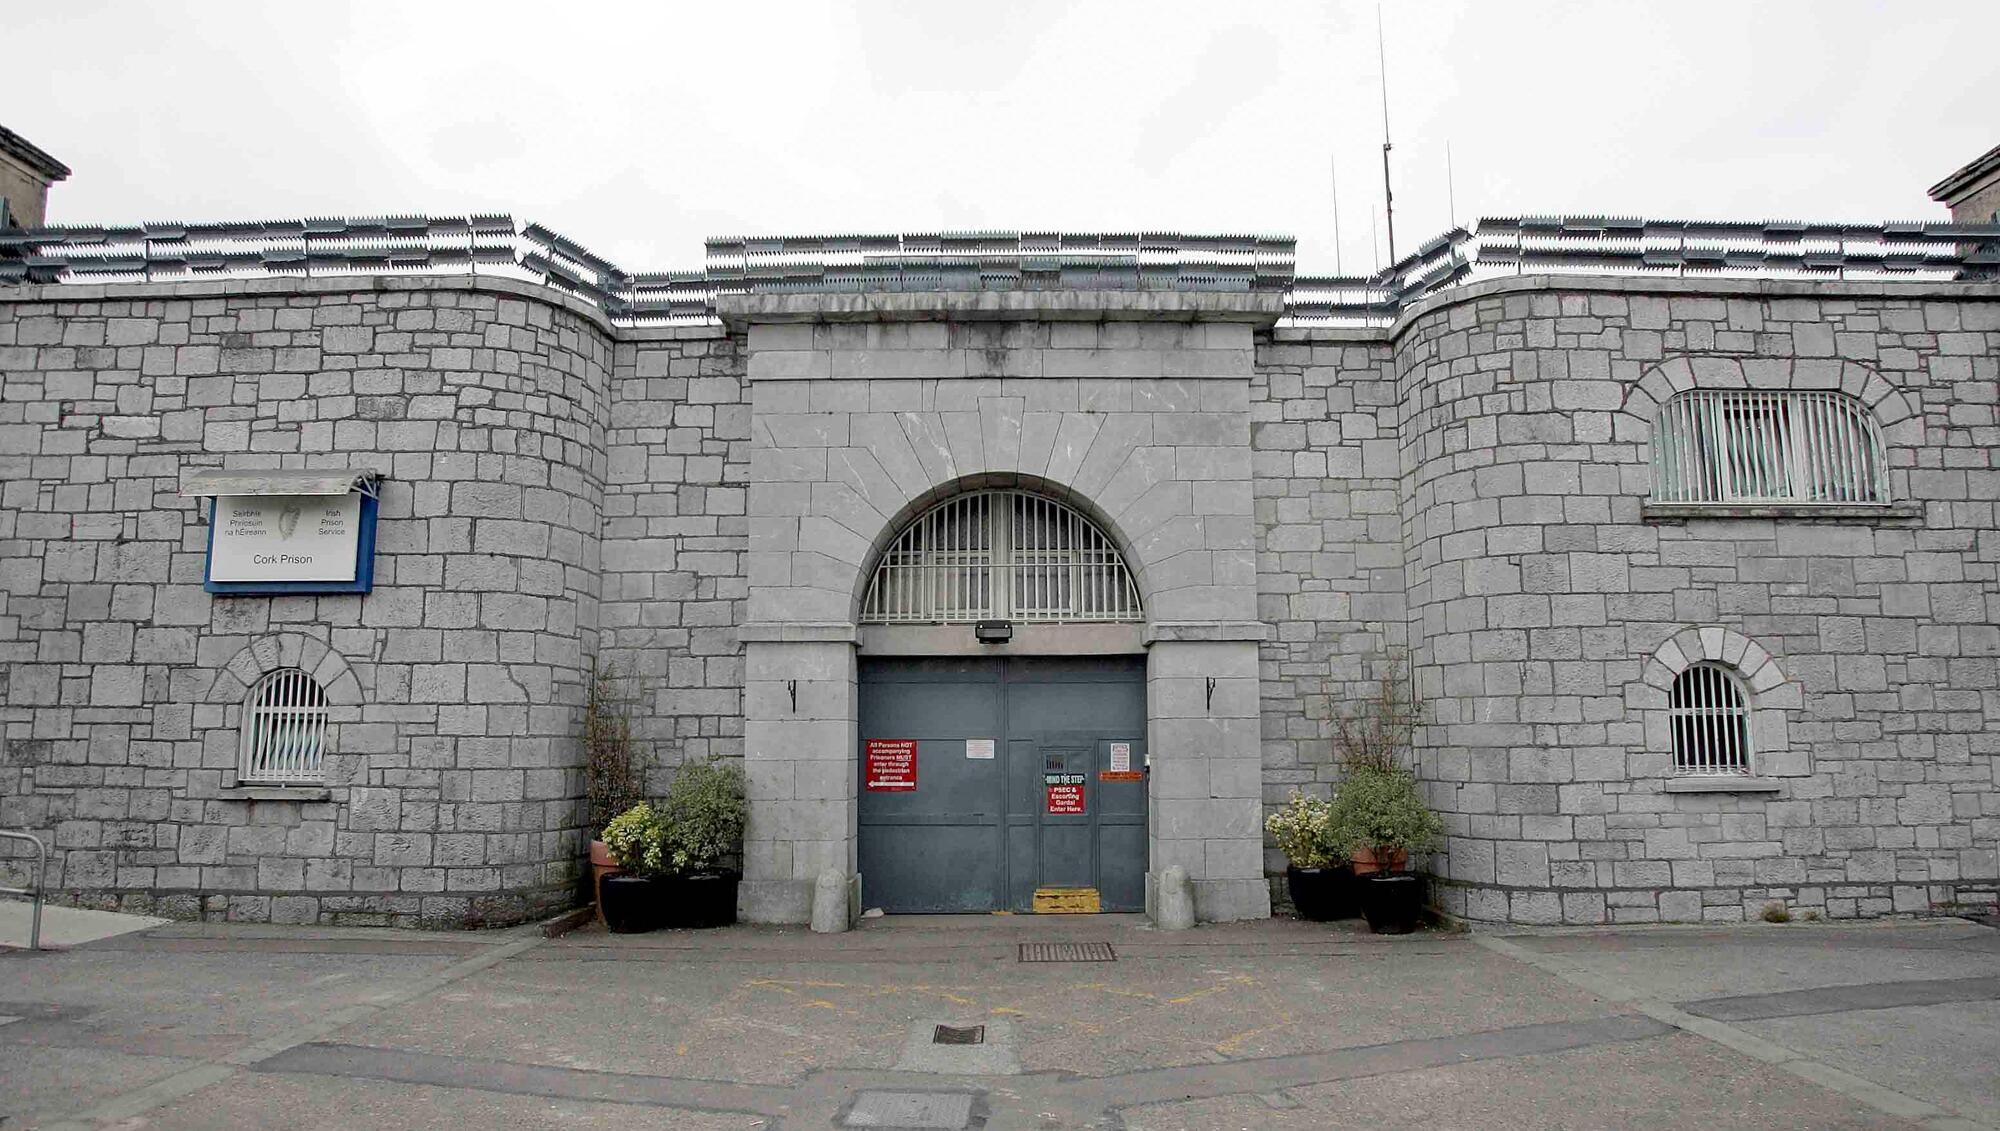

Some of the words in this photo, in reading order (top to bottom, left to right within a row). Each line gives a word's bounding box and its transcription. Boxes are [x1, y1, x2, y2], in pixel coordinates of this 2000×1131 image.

[326, 509, 341, 517] Irish
[321, 518, 344, 526] Prison
[318, 528, 345, 536] Service
[253, 554, 278, 565] Cork
[280, 554, 313, 565] Prison
[1070, 775, 1083, 784] STEP
